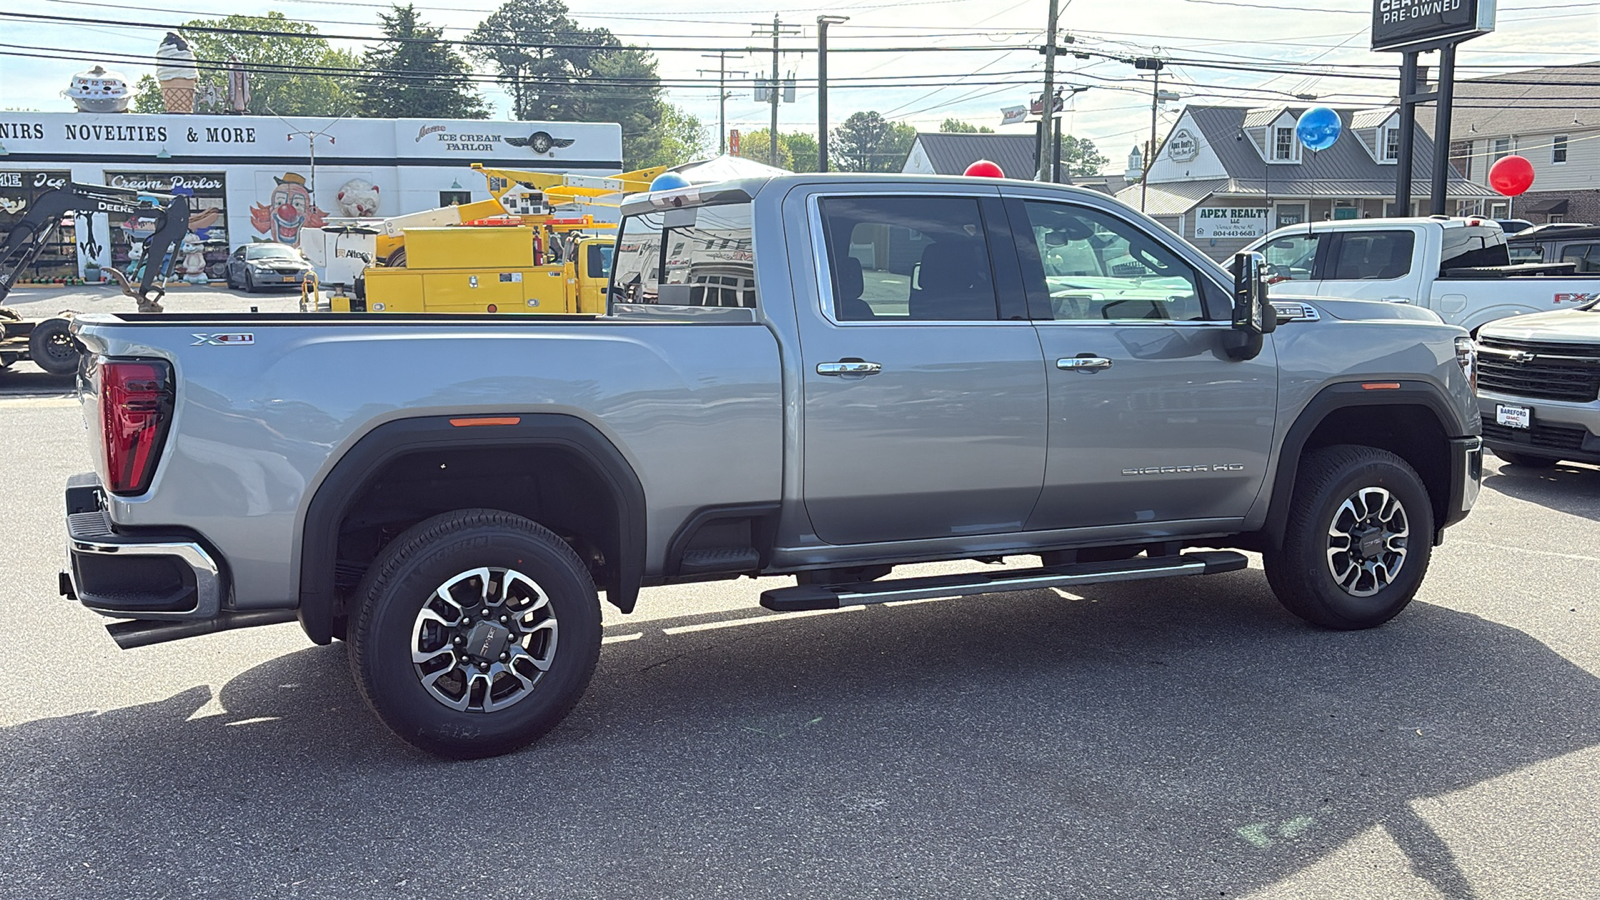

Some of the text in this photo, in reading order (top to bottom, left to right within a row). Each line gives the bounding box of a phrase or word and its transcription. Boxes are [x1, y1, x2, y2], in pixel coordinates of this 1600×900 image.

[1383, 0, 1460, 25] PRE-OWNED
[0, 123, 256, 143] NIRS NOVELTIES & MORE
[459, 134, 501, 142] CREAM
[447, 143, 493, 151] PARLOR
[111, 174, 163, 189] Cream
[170, 175, 223, 189] Parlor
[98, 201, 134, 213] DEERE
[1200, 208, 1269, 218] APEX REALTY
[1500, 408, 1526, 417] BAREFORD
[1122, 463, 1244, 475] SIERRA HD
